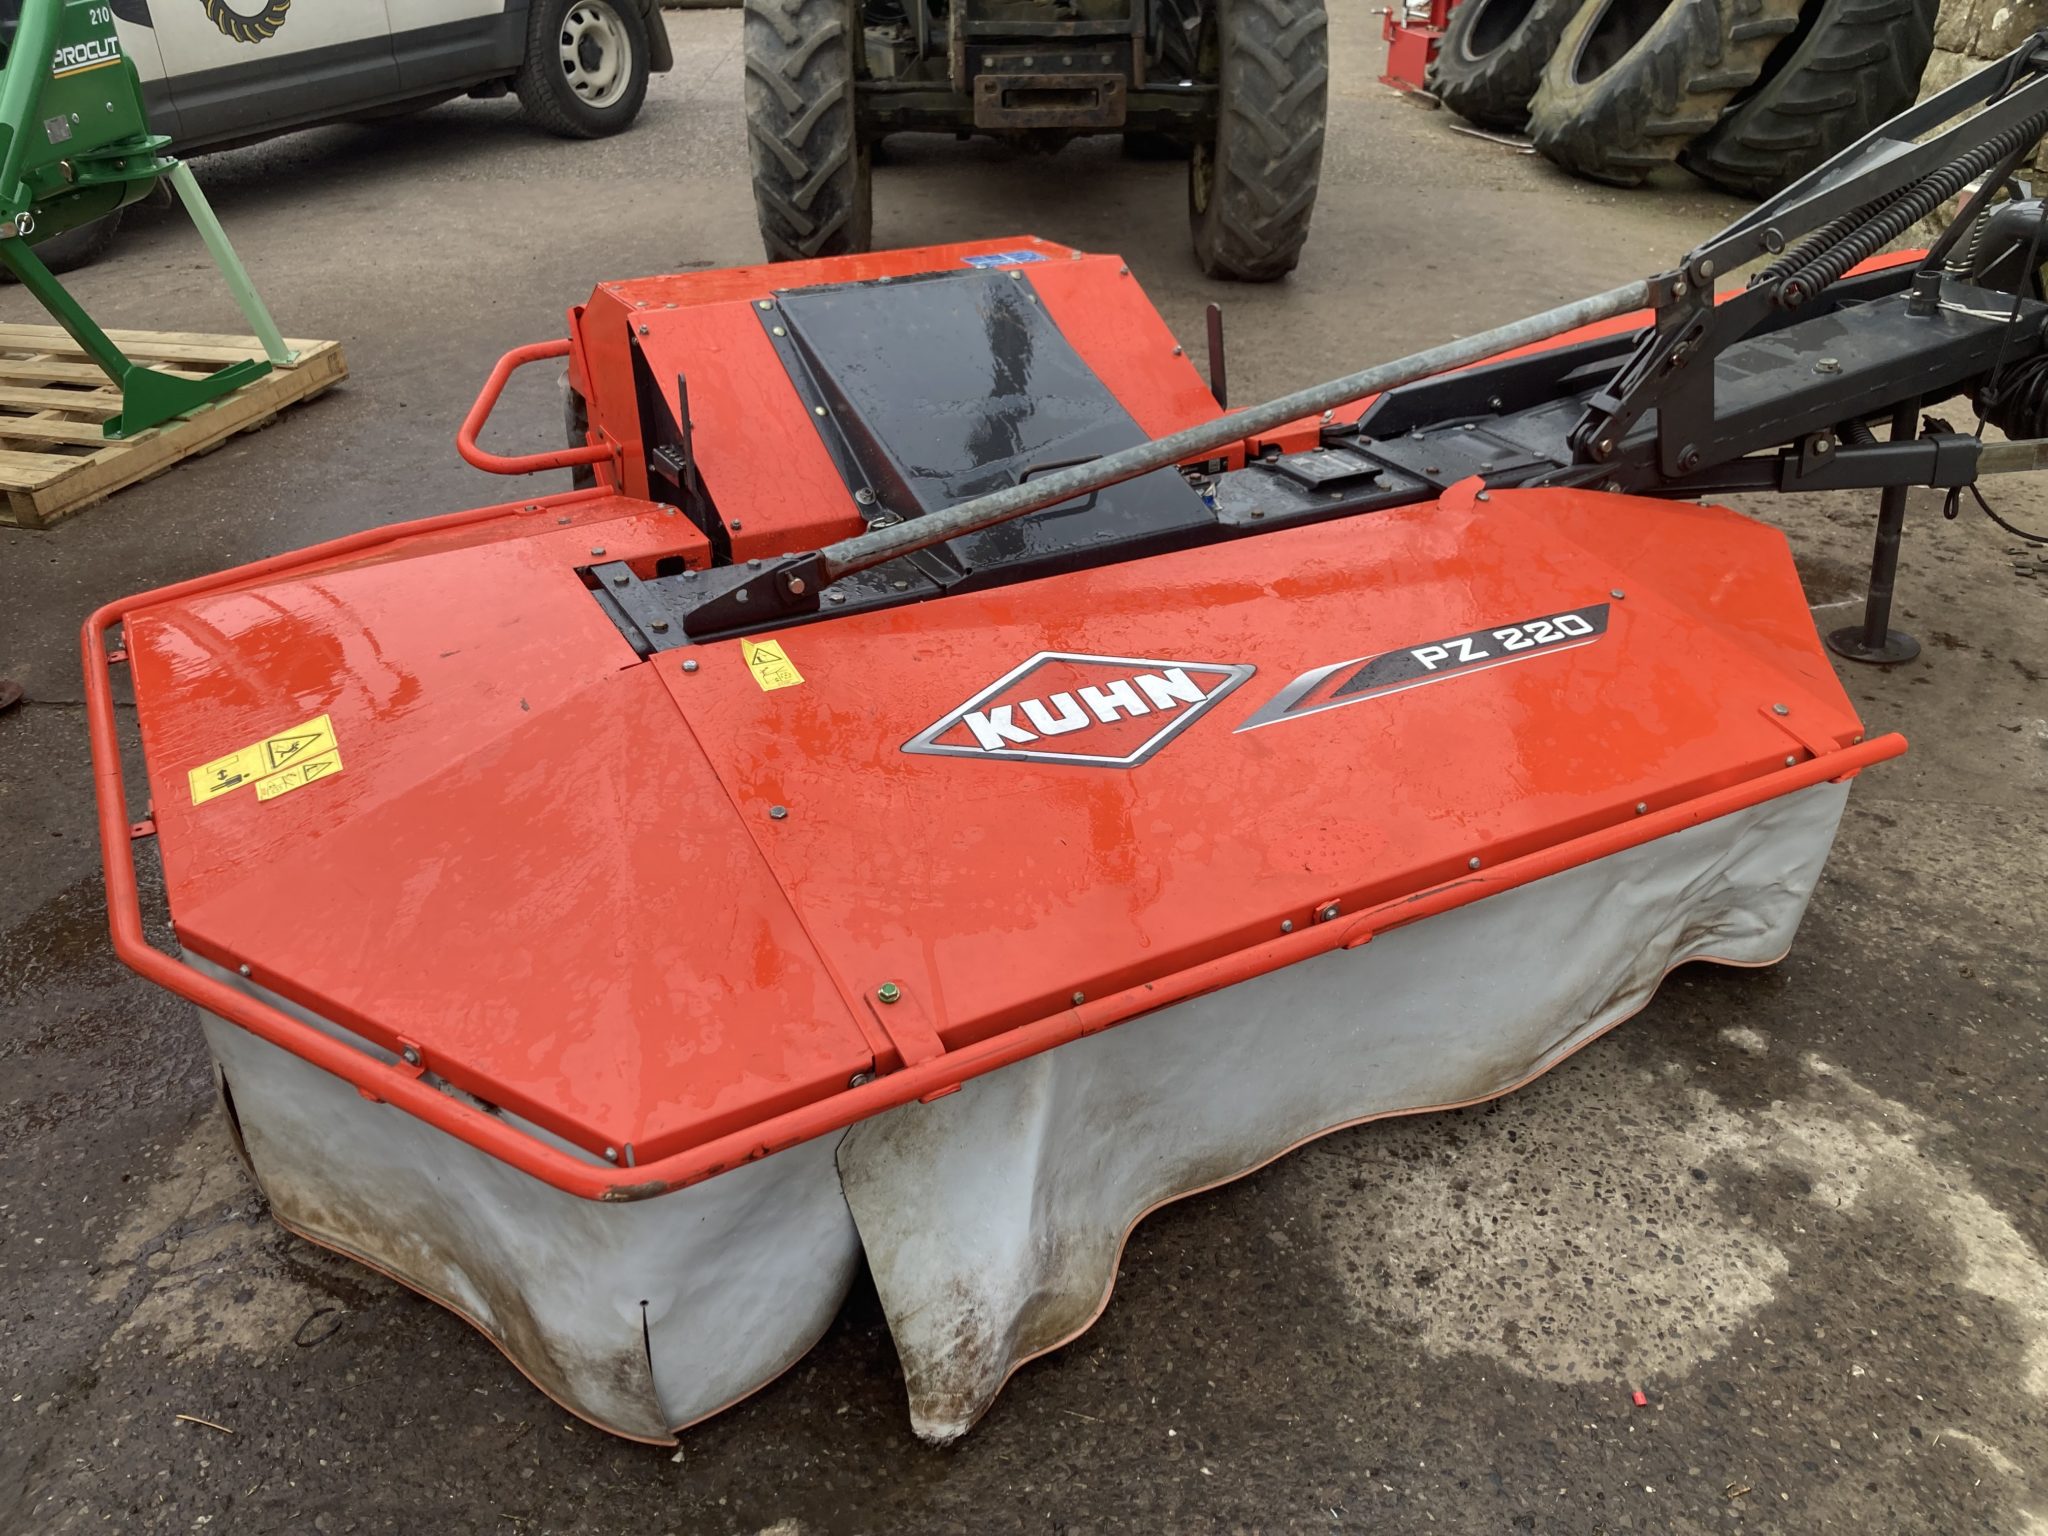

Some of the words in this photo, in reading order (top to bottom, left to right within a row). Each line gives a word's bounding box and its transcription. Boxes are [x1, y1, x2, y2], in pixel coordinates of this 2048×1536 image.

[89, 7, 110, 25] 210
[53, 36, 118, 68] PROCUT
[1411, 638, 1488, 670] PZ
[1493, 614, 1594, 651] 220
[962, 667, 1209, 751] KUHN
